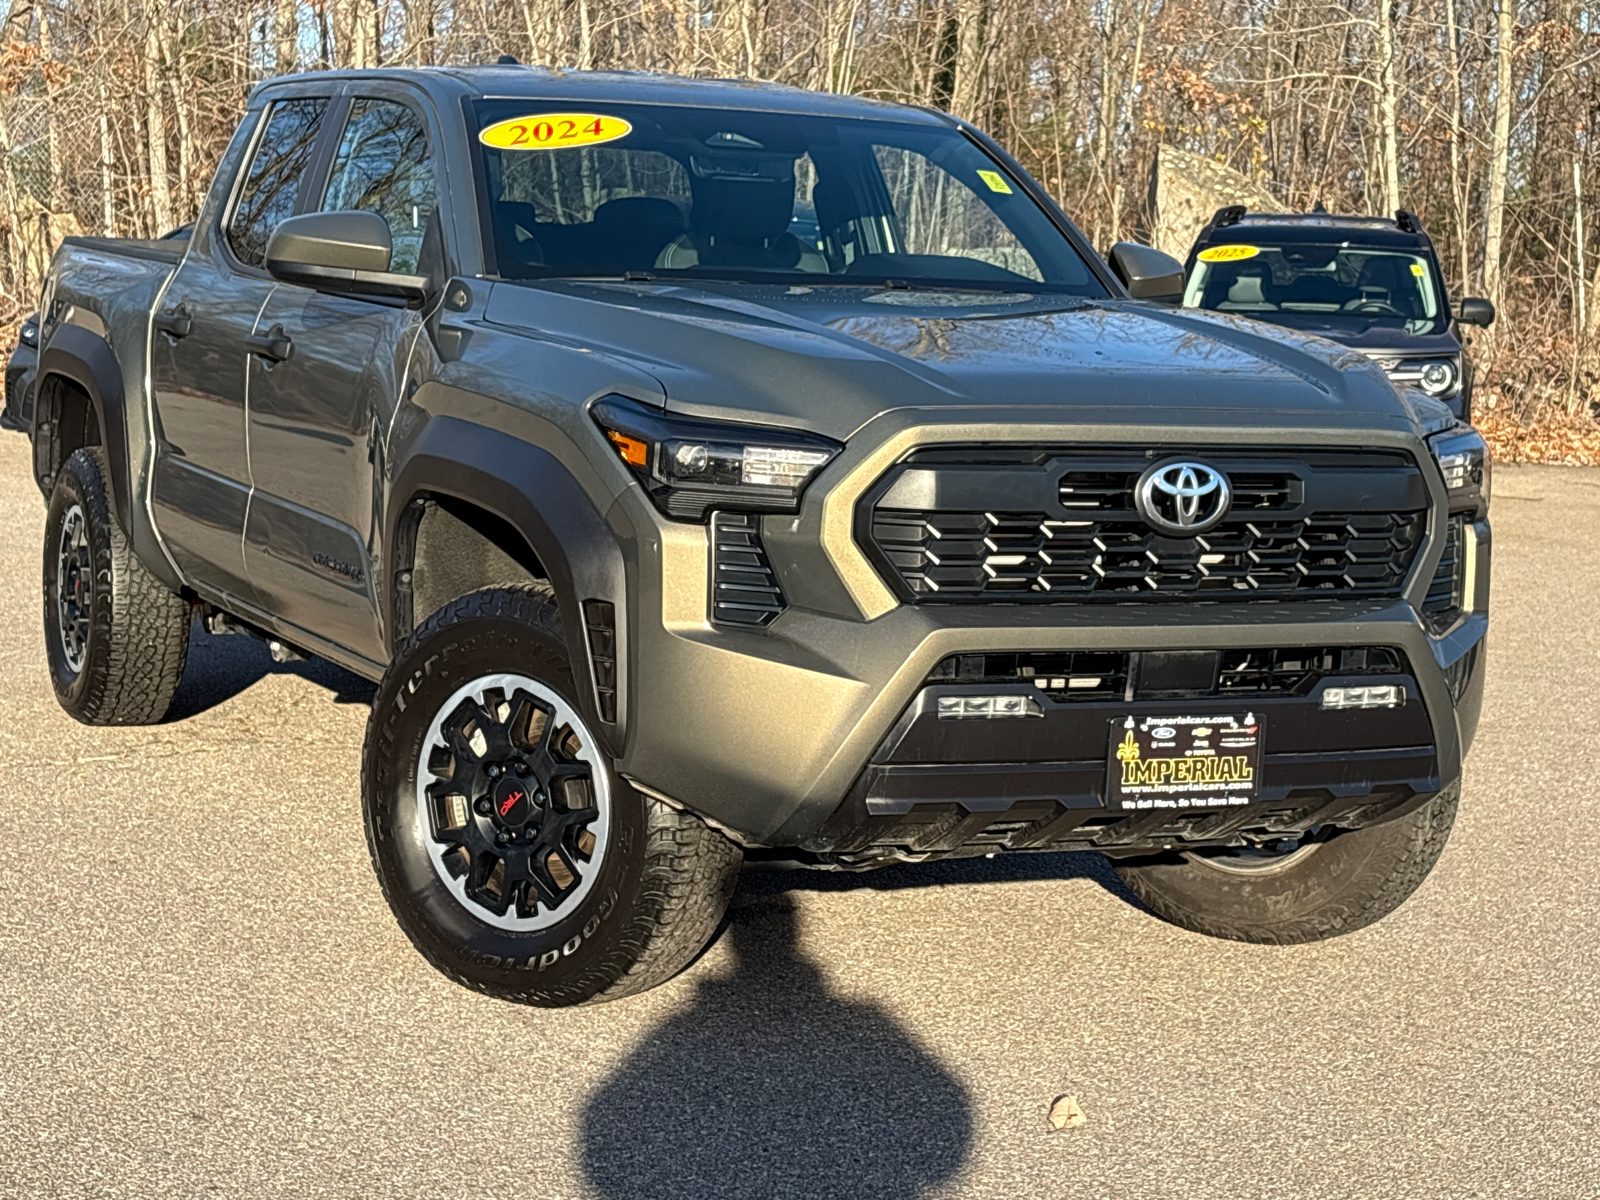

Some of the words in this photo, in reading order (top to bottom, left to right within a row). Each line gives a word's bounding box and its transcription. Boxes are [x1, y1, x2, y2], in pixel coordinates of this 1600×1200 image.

[509, 118, 604, 146] 2024
[1207, 247, 1249, 259] 2025
[1121, 756, 1252, 784] IMPERIAL
[1121, 782, 1253, 794] www.imperialcars.com
[500, 791, 523, 817] TRD
[1122, 800, 1136, 809] We
[1137, 799, 1153, 809] Sell
[1178, 798, 1190, 807] So
[1191, 797, 1207, 806] You
[1207, 797, 1228, 806] Save
[1228, 796, 1249, 805] More
